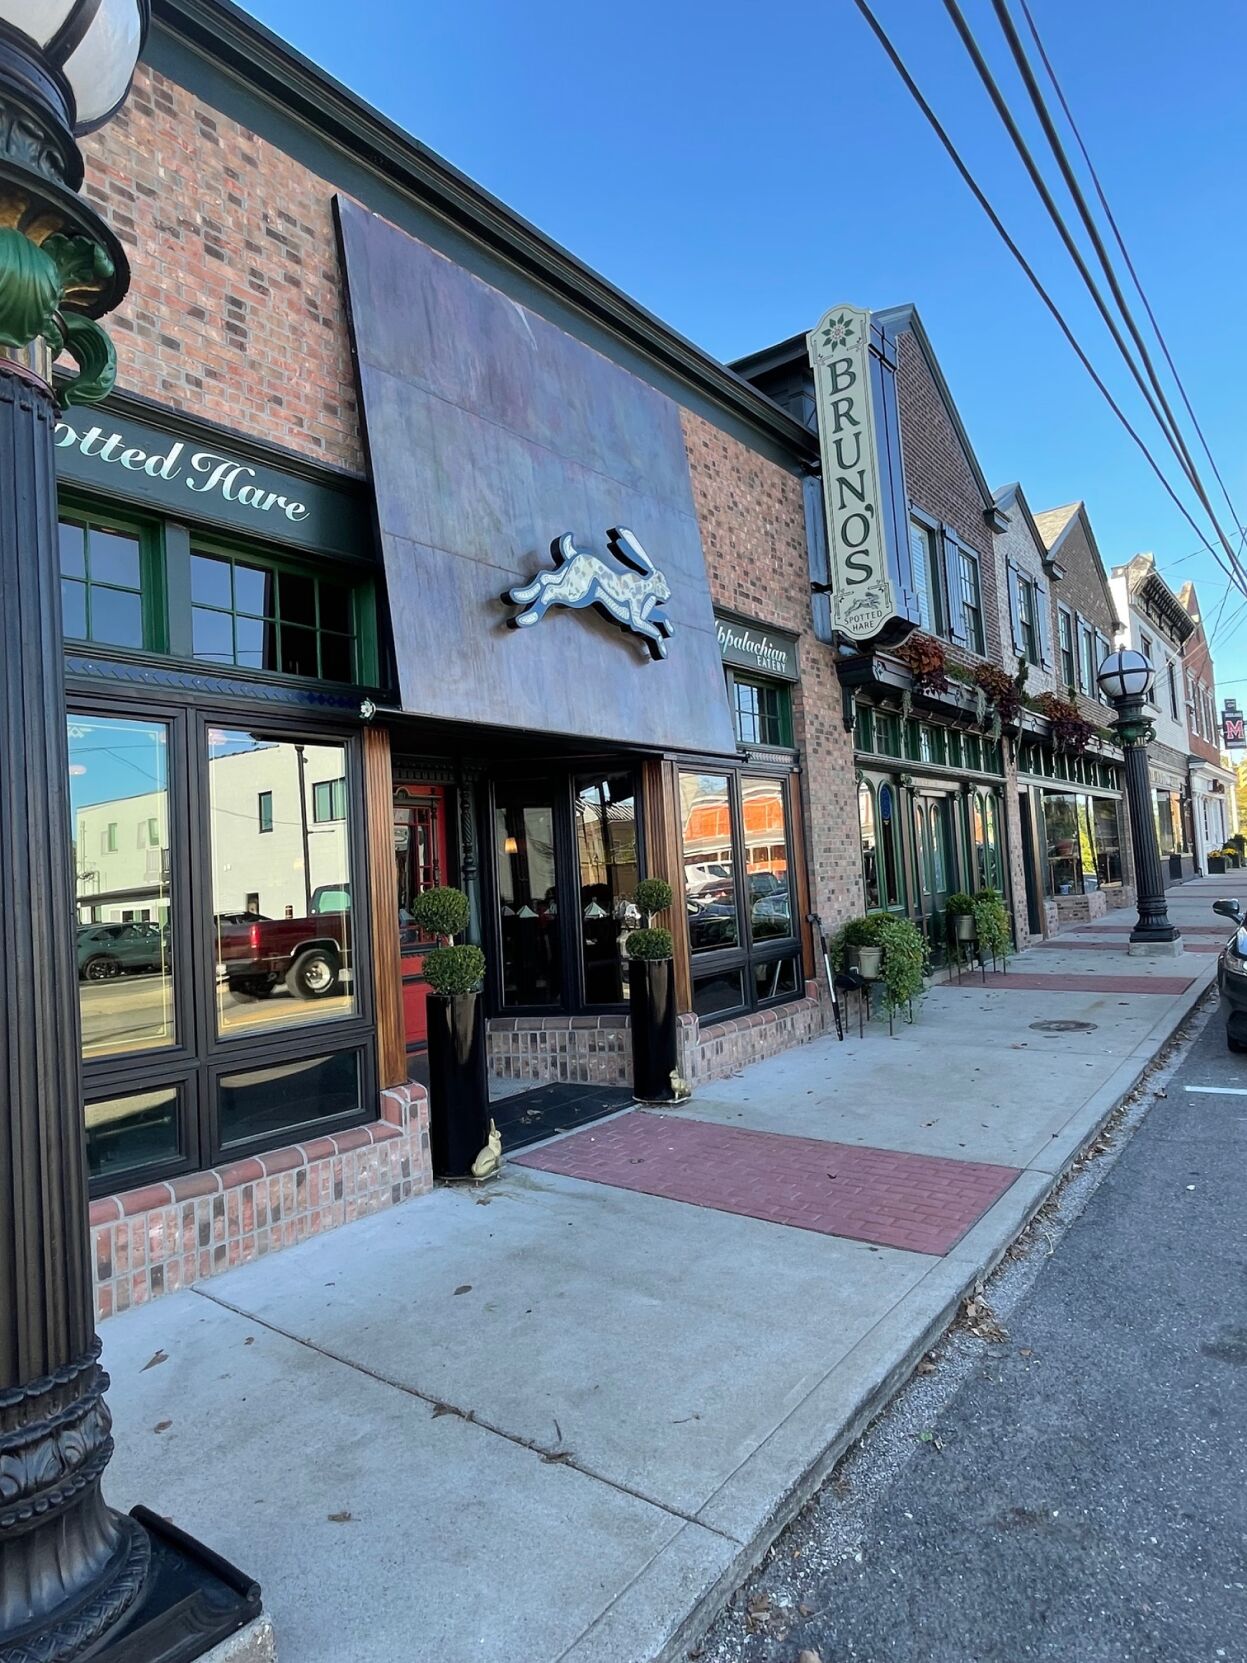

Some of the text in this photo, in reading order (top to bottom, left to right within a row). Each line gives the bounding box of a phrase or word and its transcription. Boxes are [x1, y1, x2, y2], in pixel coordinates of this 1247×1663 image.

[54, 423, 310, 522] otted Hare
[826, 357, 875, 586] BRUNO'S
[844, 610, 883, 625] SPOTTED
[852, 620, 875, 631] HARE
[715, 620, 788, 663] ppalachian
[756, 655, 786, 673] EATERY
[1225, 720, 1244, 740] M
